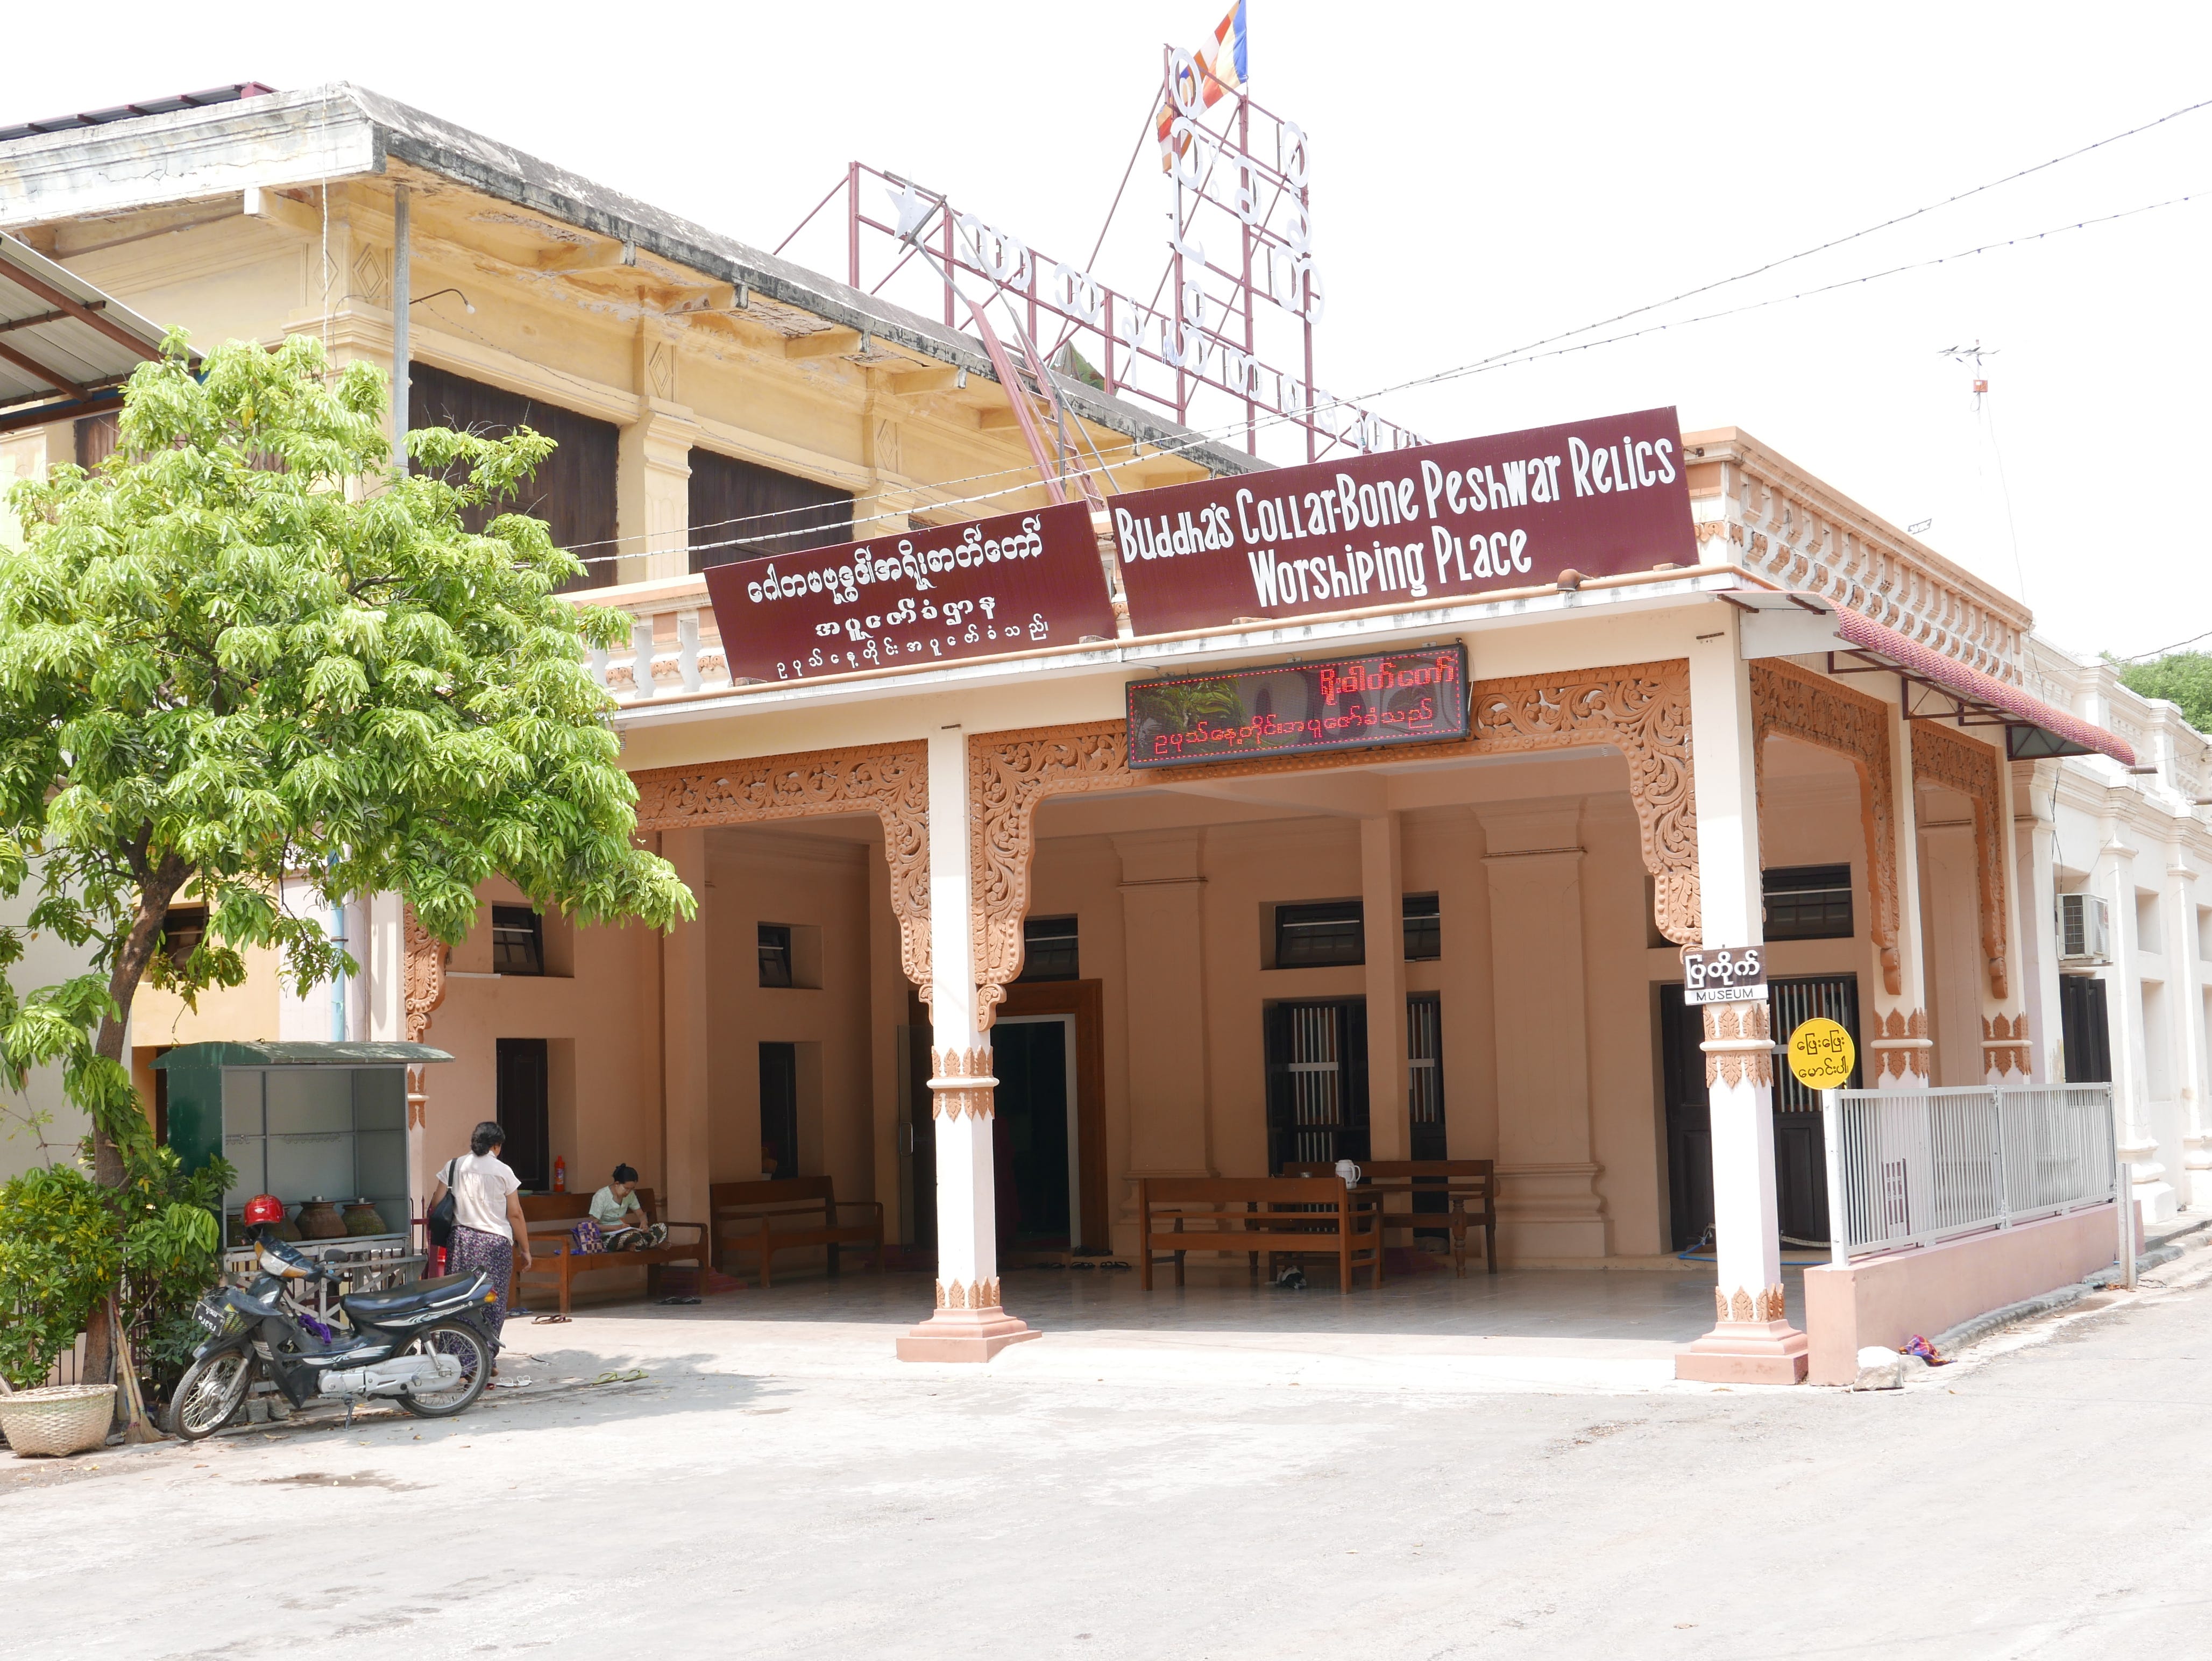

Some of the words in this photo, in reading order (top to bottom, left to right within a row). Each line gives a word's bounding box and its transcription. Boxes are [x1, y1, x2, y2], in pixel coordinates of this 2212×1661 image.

[1115, 502, 1234, 563] Buddha's
[1248, 541, 1428, 607] Worshiping
[1685, 949, 1760, 989] ပြတိုက်
[1696, 988, 1754, 1002] MUSEUM
[1797, 1029, 1845, 1055] ဖြေးဖြေး
